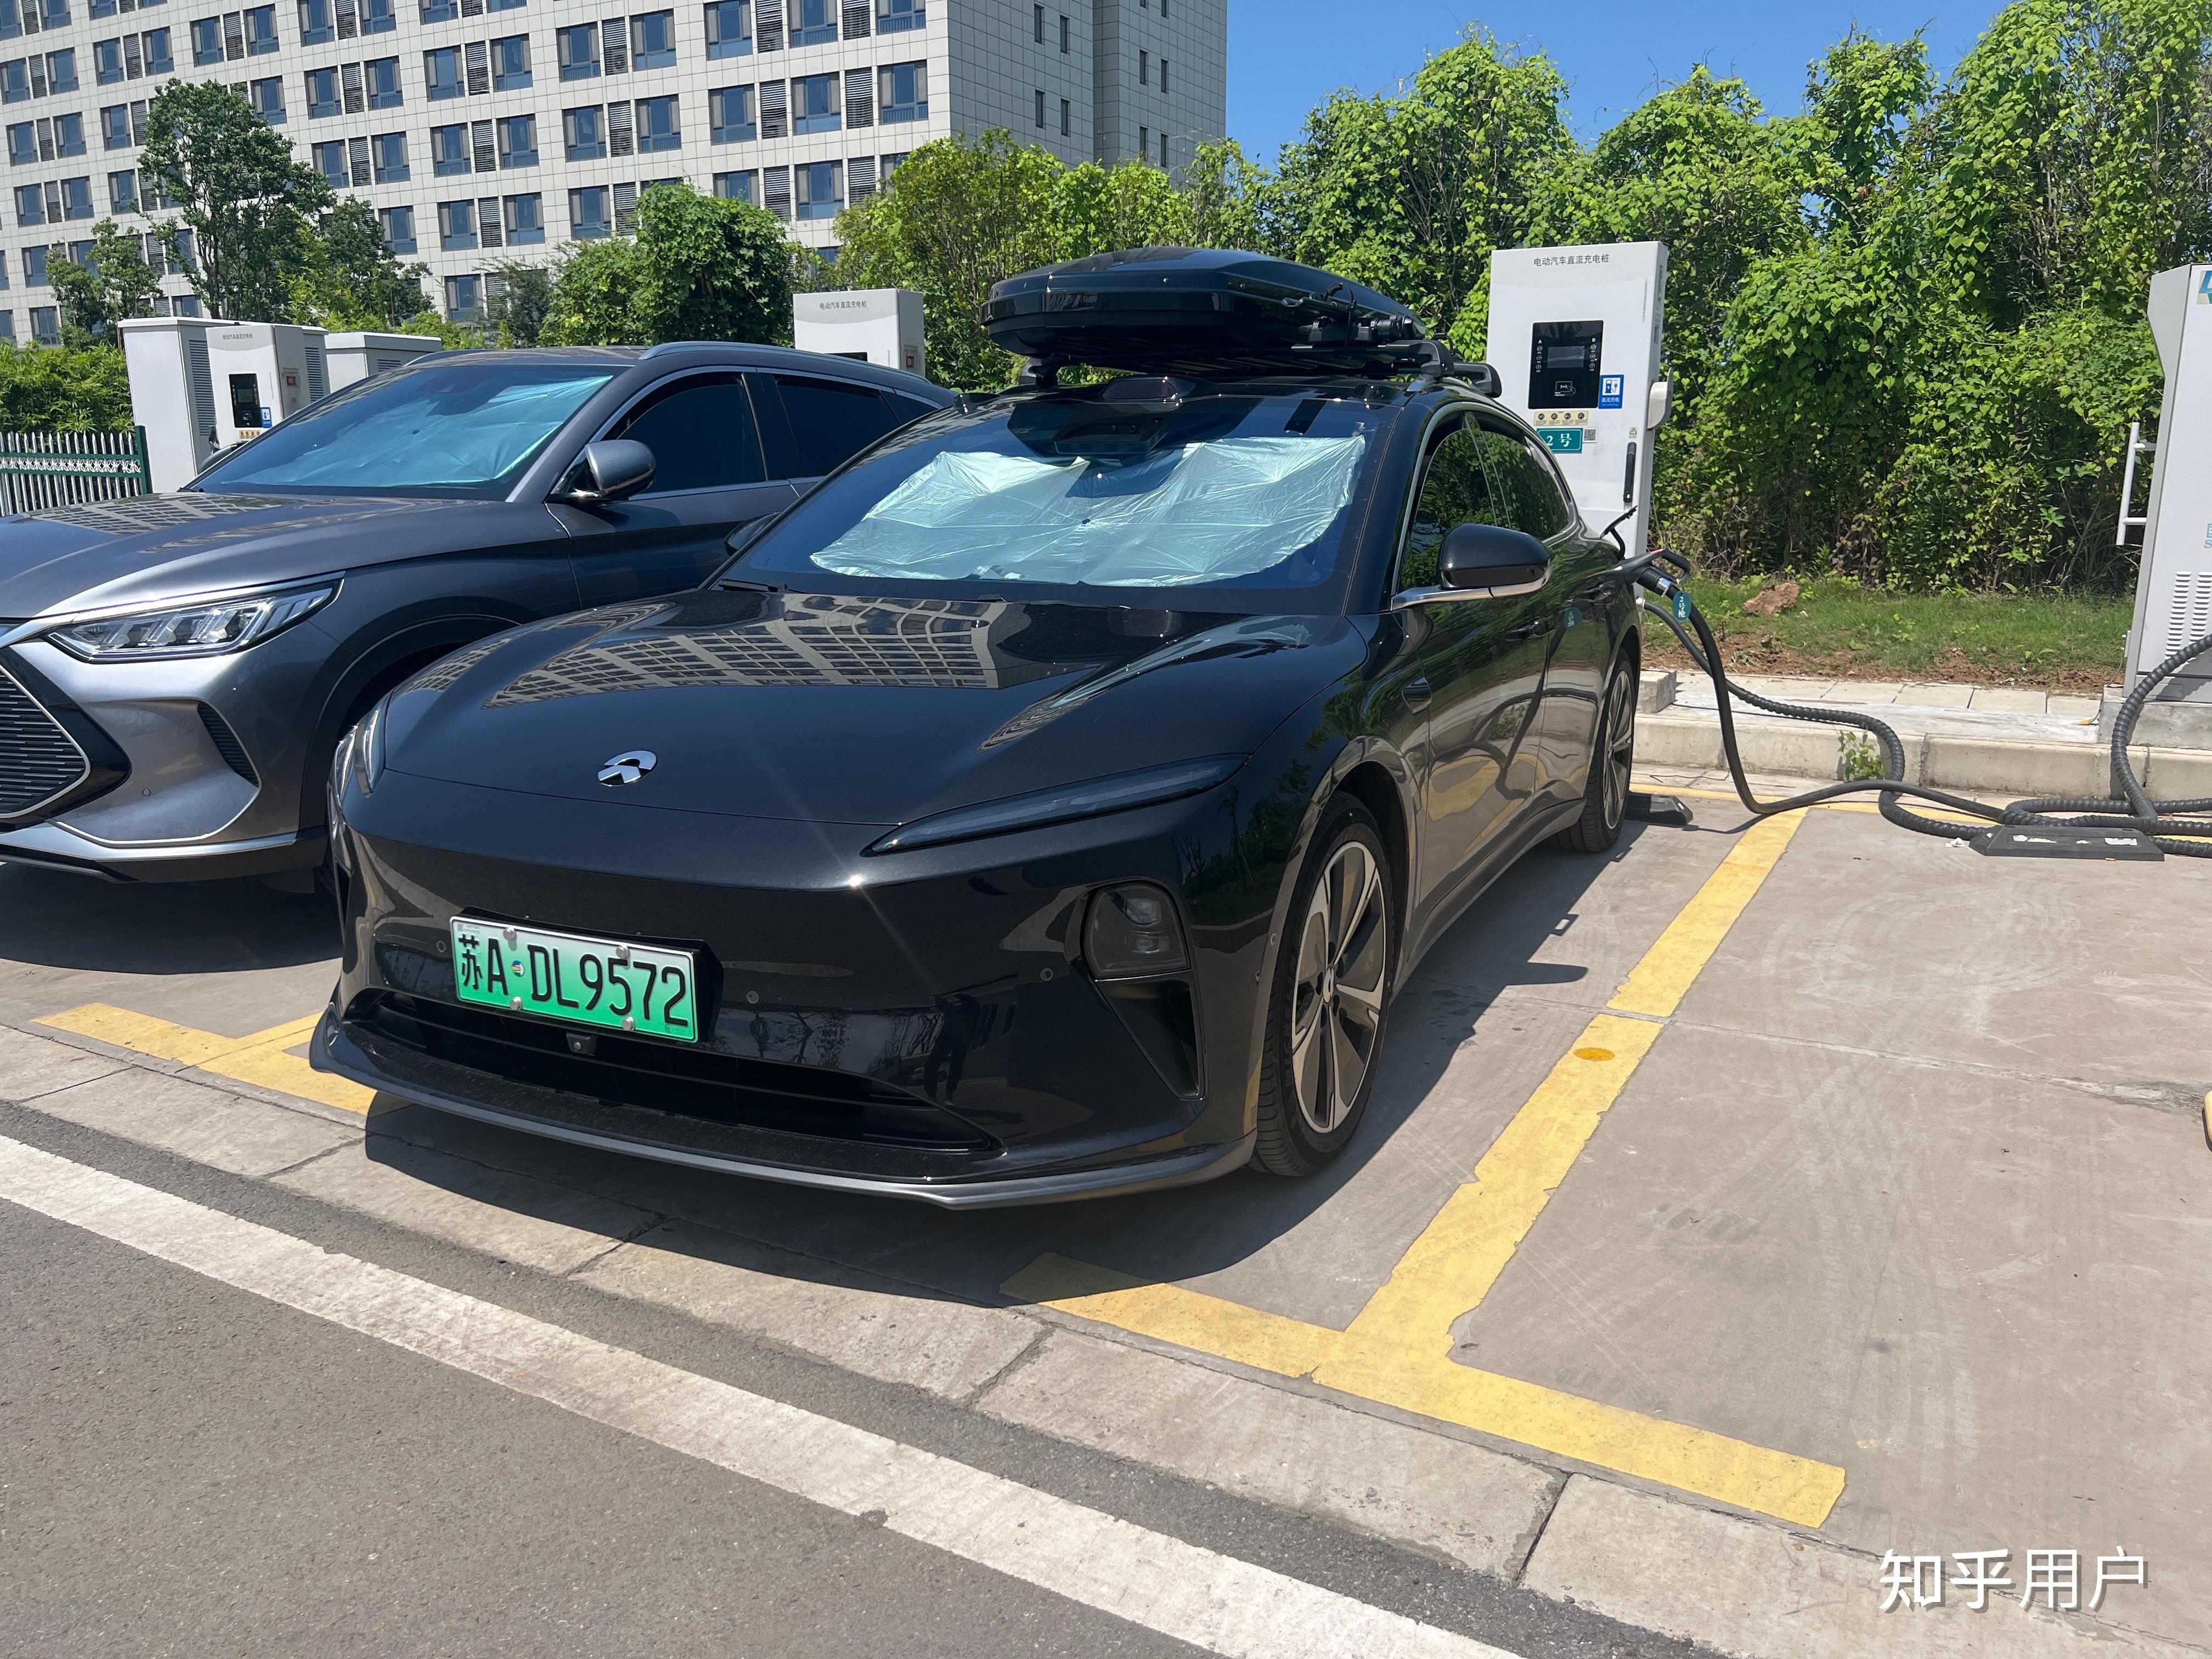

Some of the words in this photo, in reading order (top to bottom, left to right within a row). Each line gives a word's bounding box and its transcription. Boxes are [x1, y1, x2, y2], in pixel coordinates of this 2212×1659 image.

[1533, 253, 1610, 267] 电动汽车直流充电桩
[820, 300, 867, 309] 电动汽车直流充电桩
